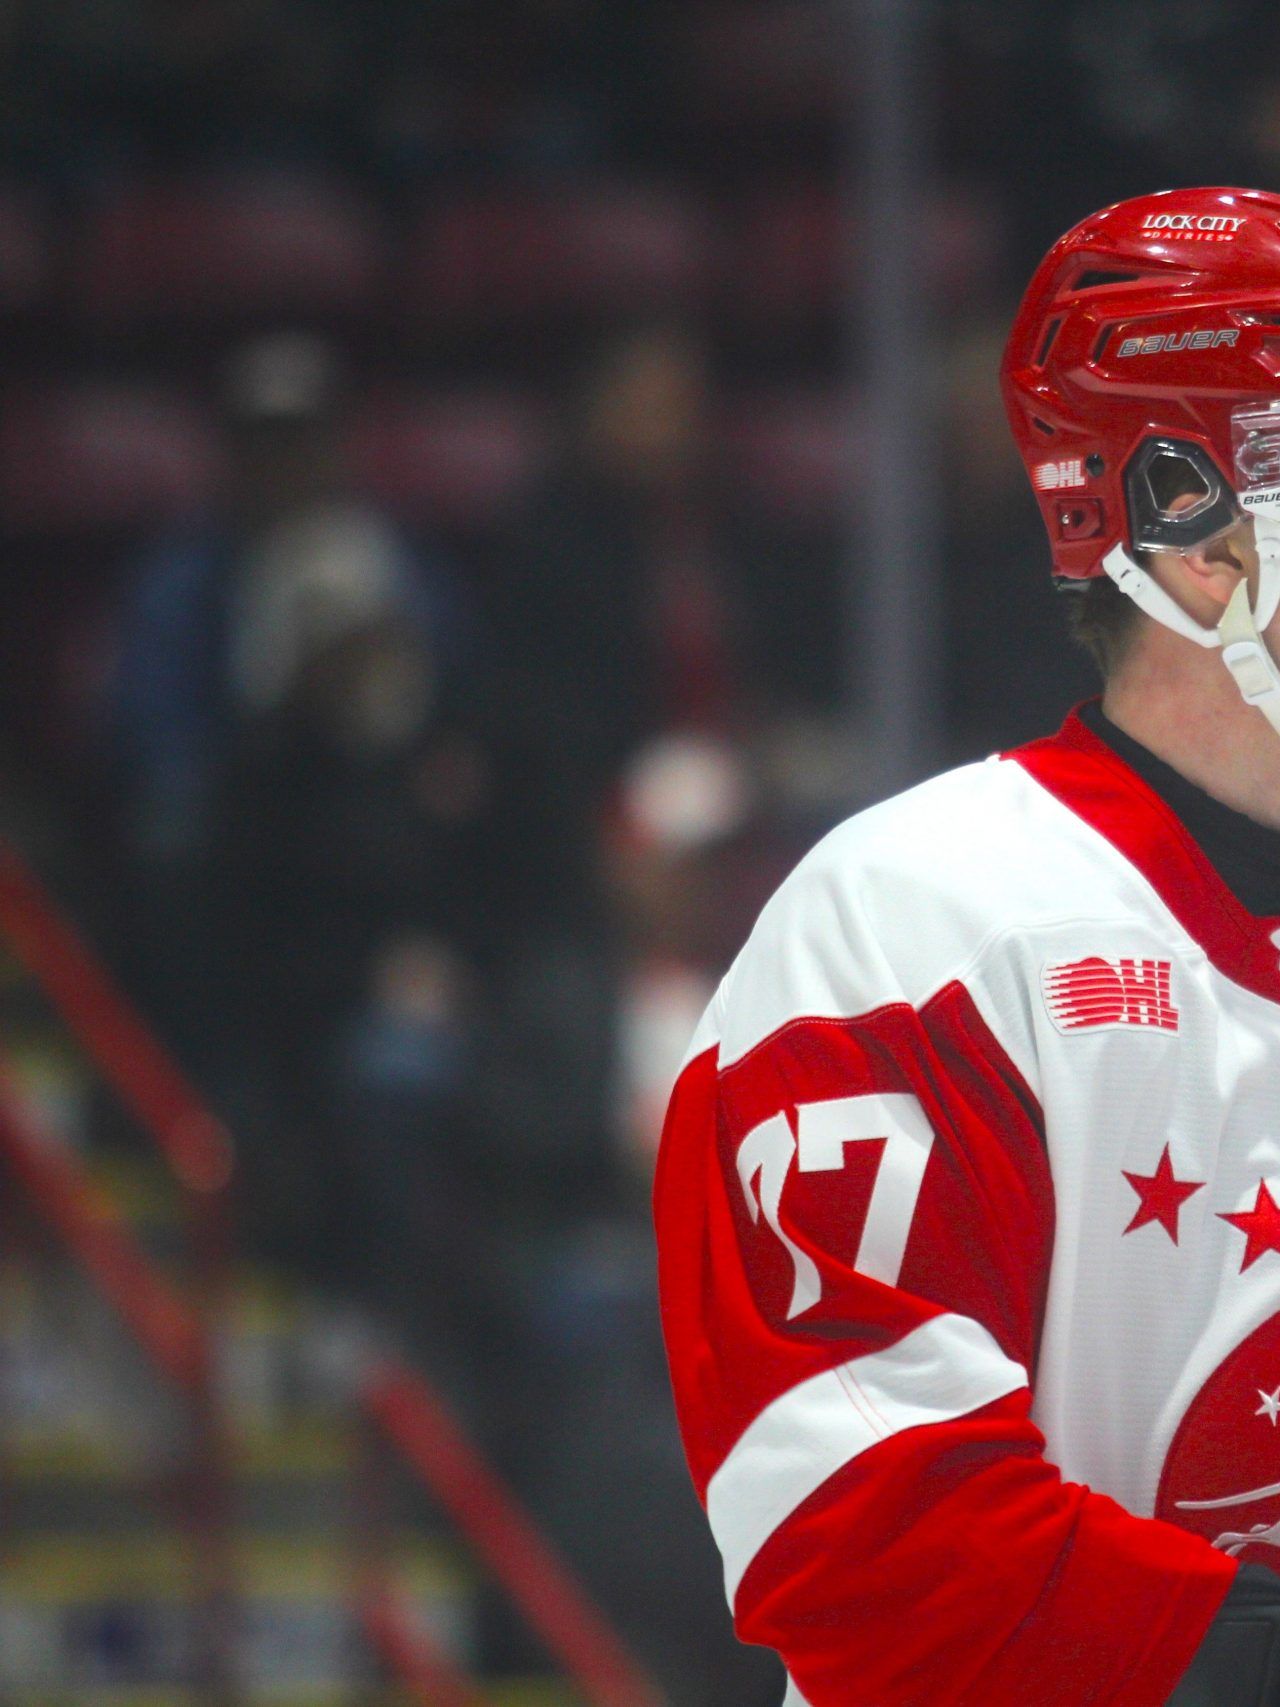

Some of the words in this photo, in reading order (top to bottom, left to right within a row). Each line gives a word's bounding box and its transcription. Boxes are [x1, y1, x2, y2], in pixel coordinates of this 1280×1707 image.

[1142, 214, 1197, 230] LOCK
[1197, 216, 1247, 232] CITY
[1151, 231, 1225, 242] DAIRIES
[1117, 329, 1240, 358] BAUER
[1035, 460, 1086, 489] OHL
[1044, 956, 1179, 1031] OHL
